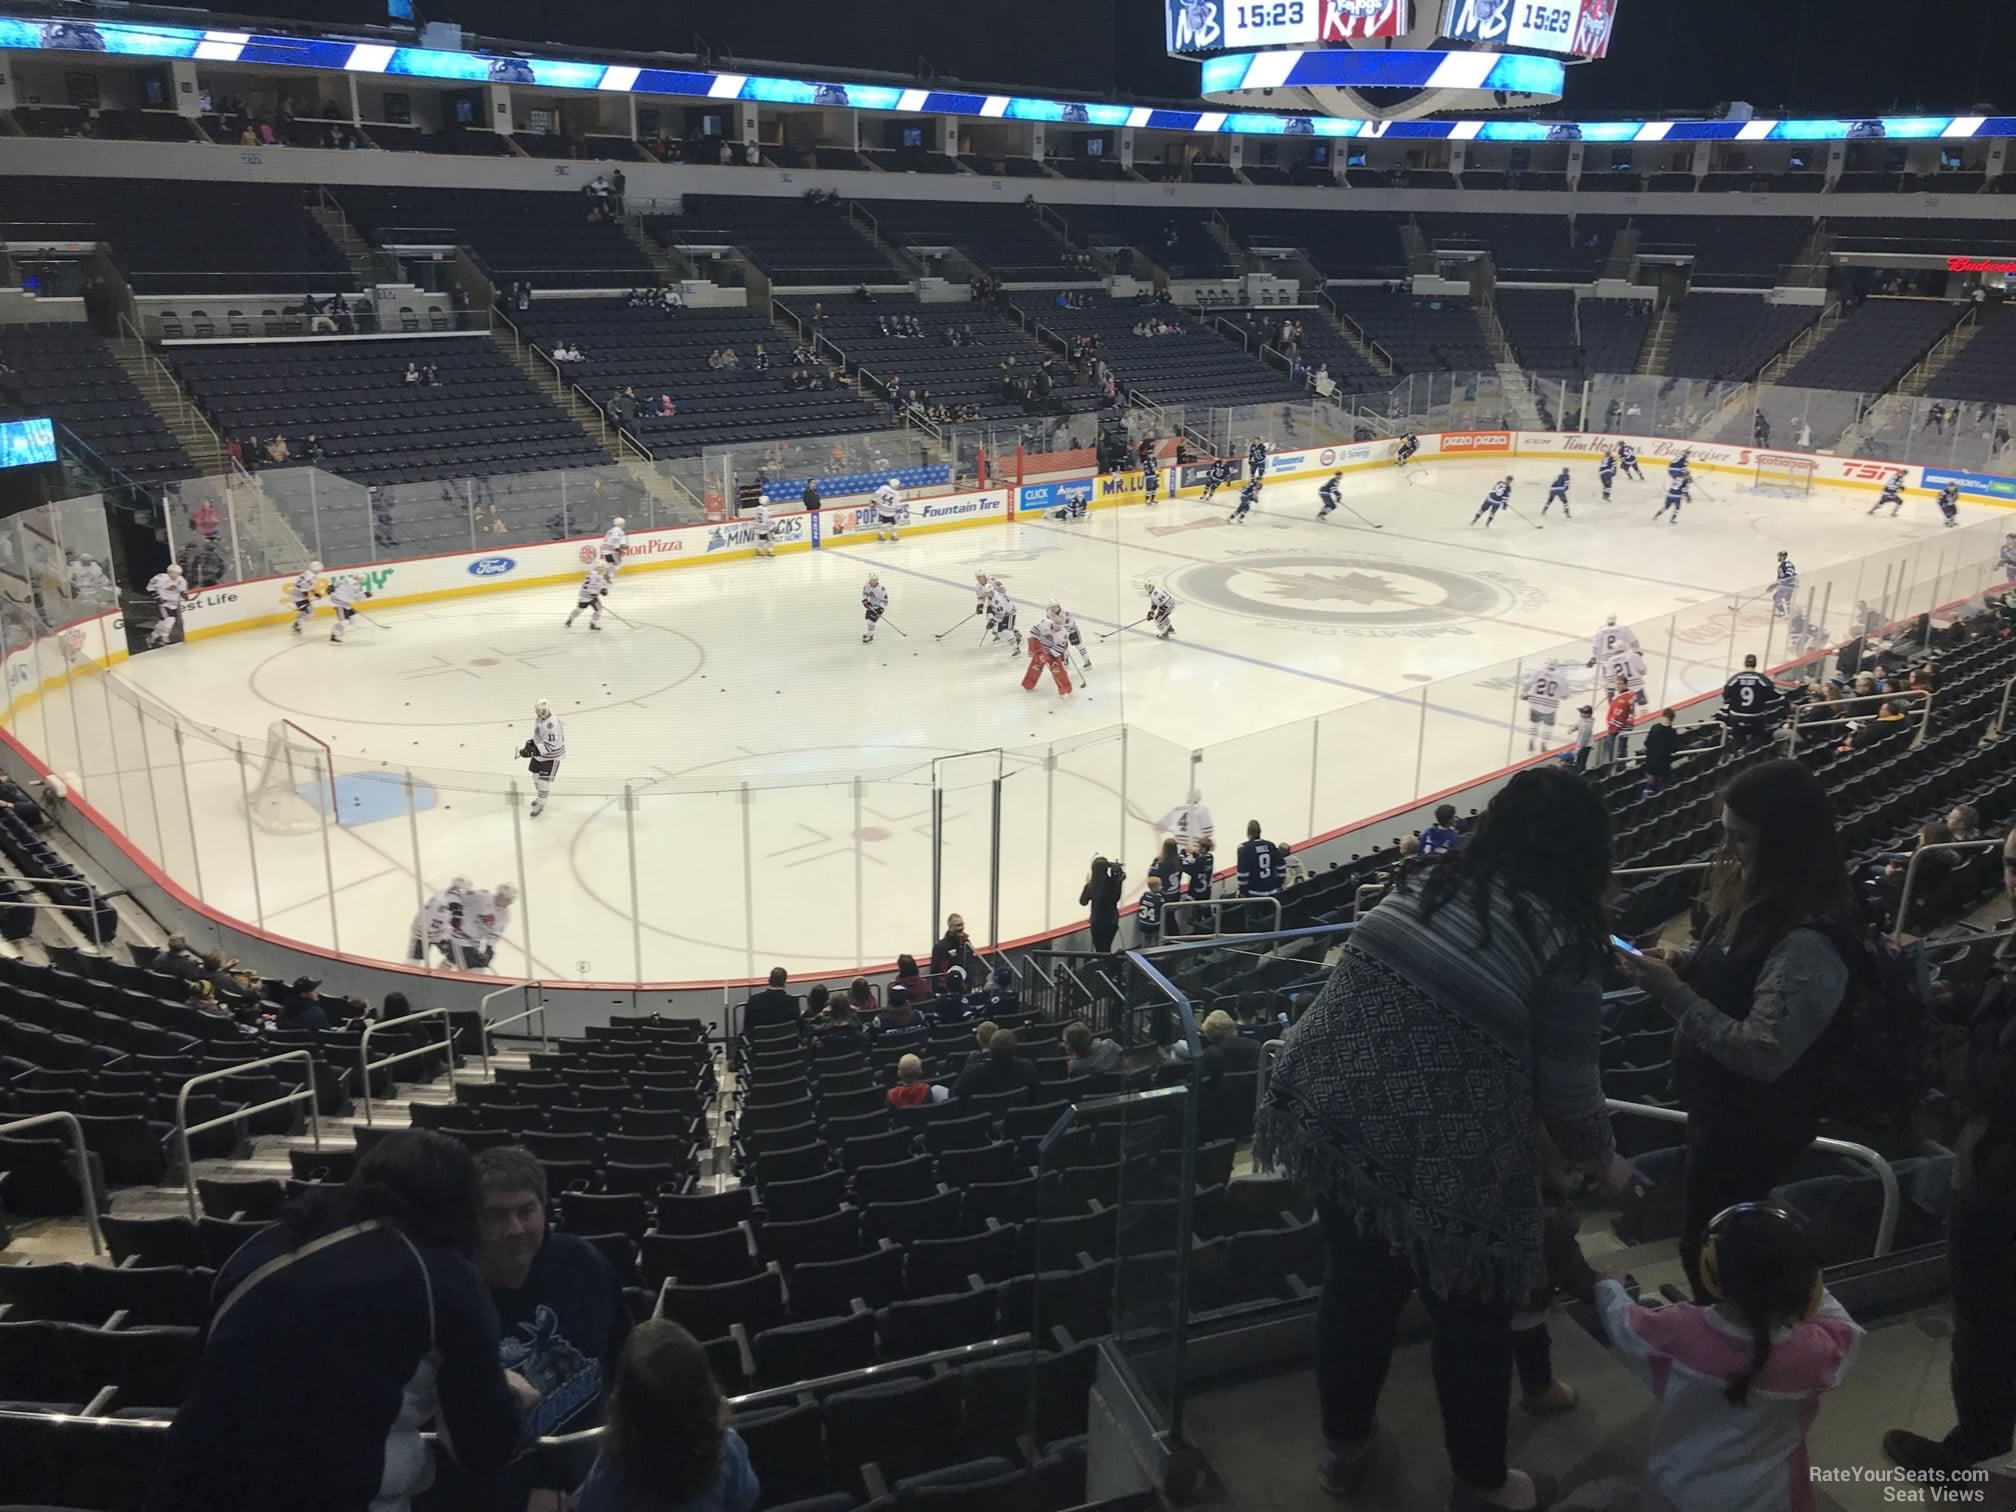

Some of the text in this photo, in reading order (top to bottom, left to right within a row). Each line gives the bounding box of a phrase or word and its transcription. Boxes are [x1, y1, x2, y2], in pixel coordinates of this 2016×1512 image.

[1237, 2, 1304, 28] 15:23
[1522, 4, 1571, 33] 15:23
[1443, 435, 1508, 449] pizza pizza
[1563, 435, 1587, 450] Tim
[1755, 454, 1820, 471] Scotiabank
[1843, 462, 1902, 480] TSN
[1025, 488, 1048, 500] CLICK
[1103, 480, 1128, 495] MR.
[922, 501, 976, 517] Fountain
[979, 498, 1000, 511] Tire
[648, 539, 682, 554] Pizza
[476, 559, 508, 575] Ford
[207, 592, 239, 606] Life
[1739, 686, 1755, 706] 9
[1259, 853, 1271, 879] 9
[1138, 905, 1156, 922] 34
